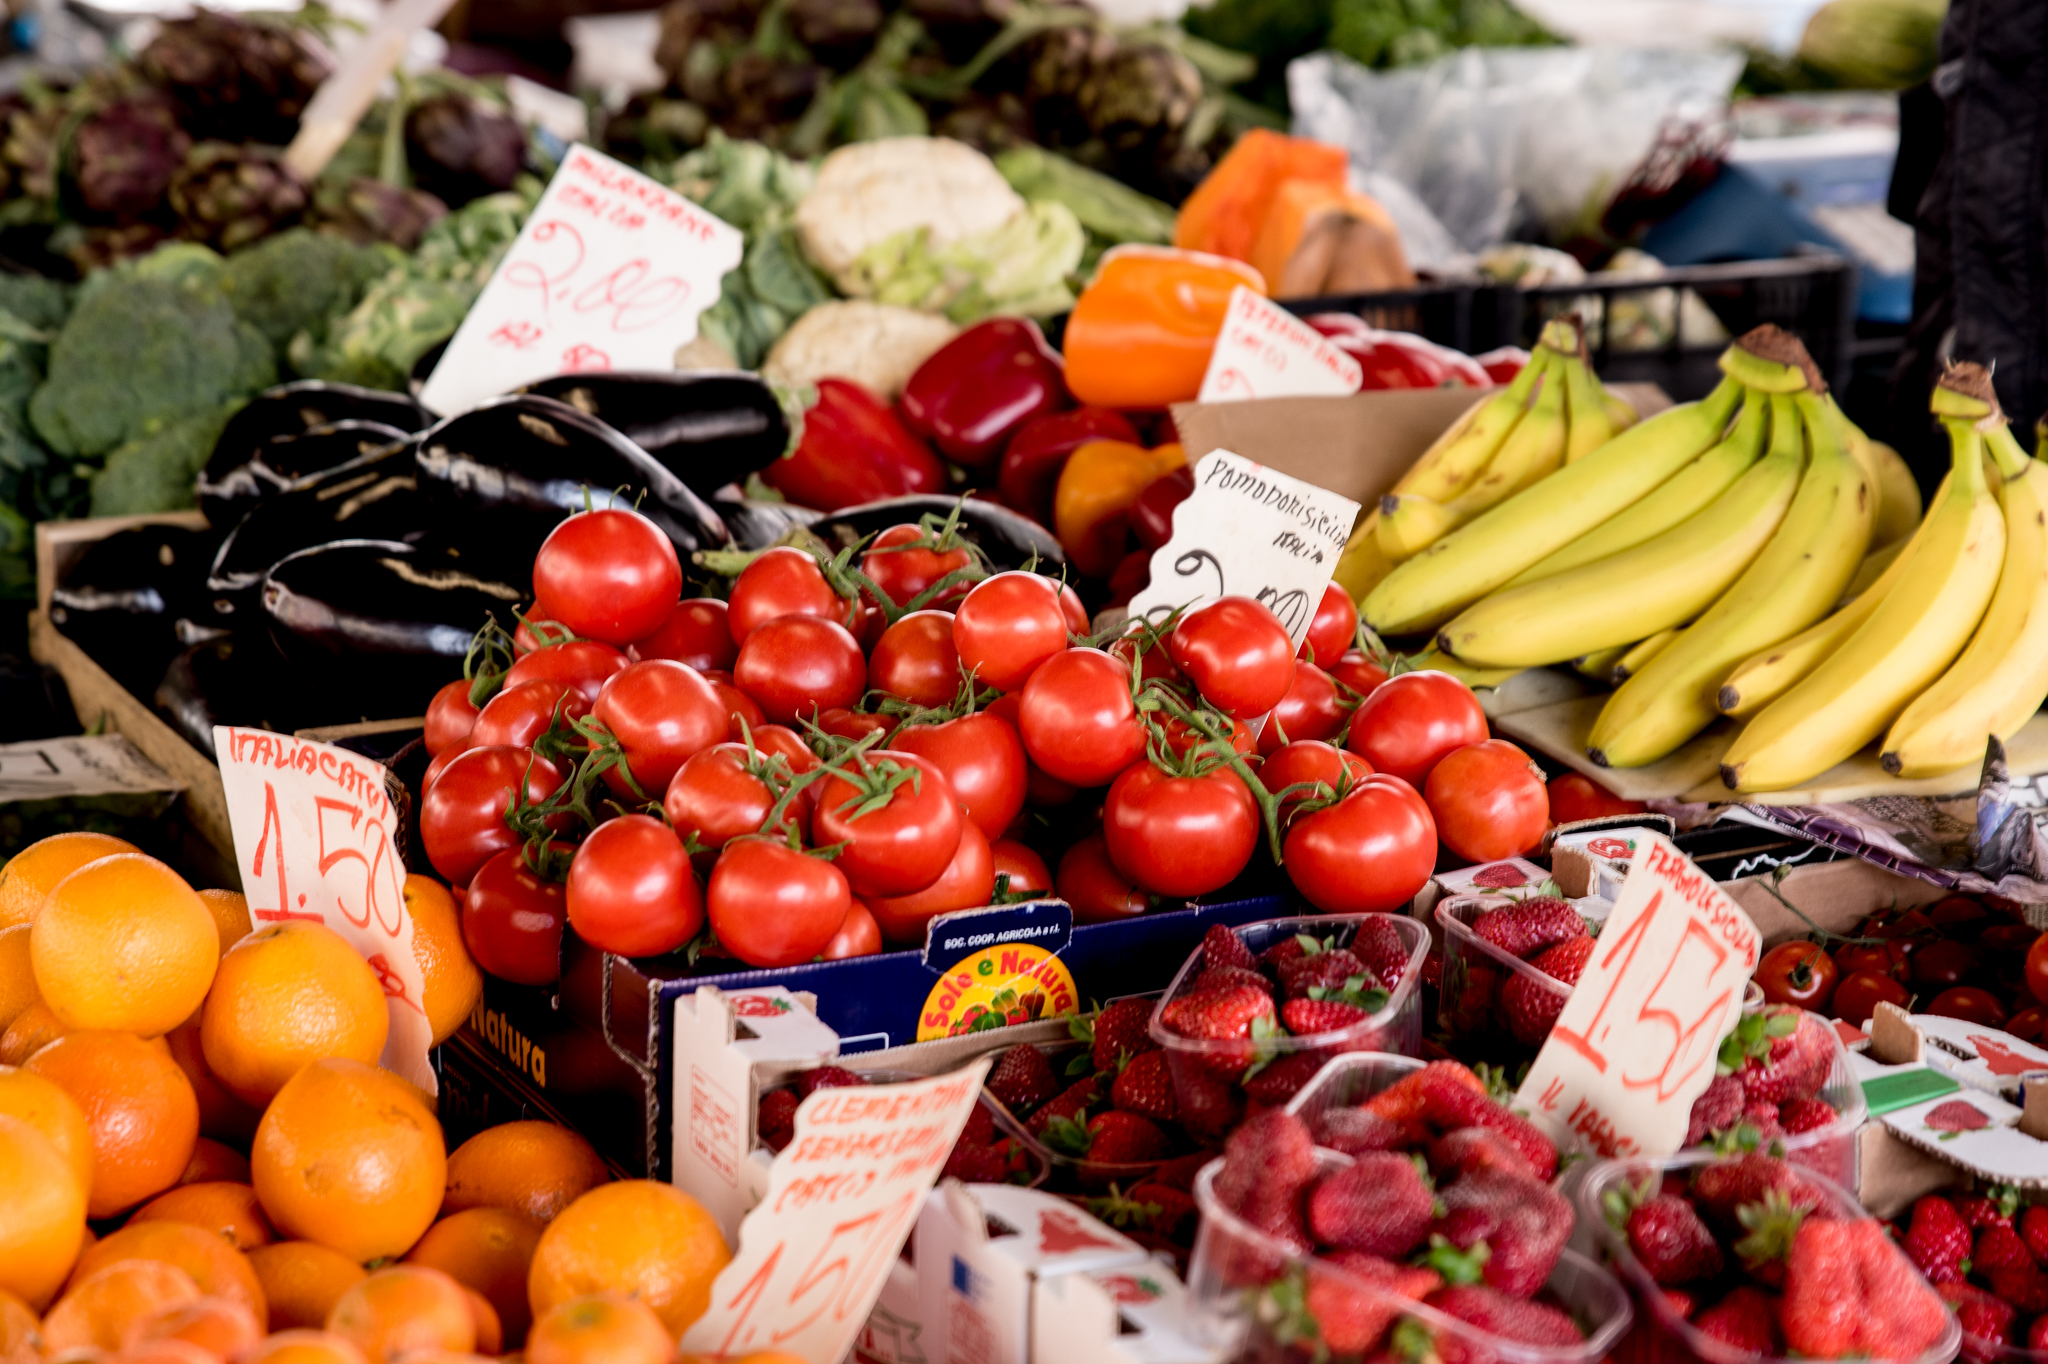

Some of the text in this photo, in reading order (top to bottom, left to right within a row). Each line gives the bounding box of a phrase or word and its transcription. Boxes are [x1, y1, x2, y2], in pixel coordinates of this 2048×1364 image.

[1272, 529, 1325, 564] ITALIA
[943, 936, 967, 951] SOC.
[967, 932, 996, 947] COOP.
[996, 925, 1042, 943] AGRICOLA
[924, 949, 1073, 1028] Sole e Natura
